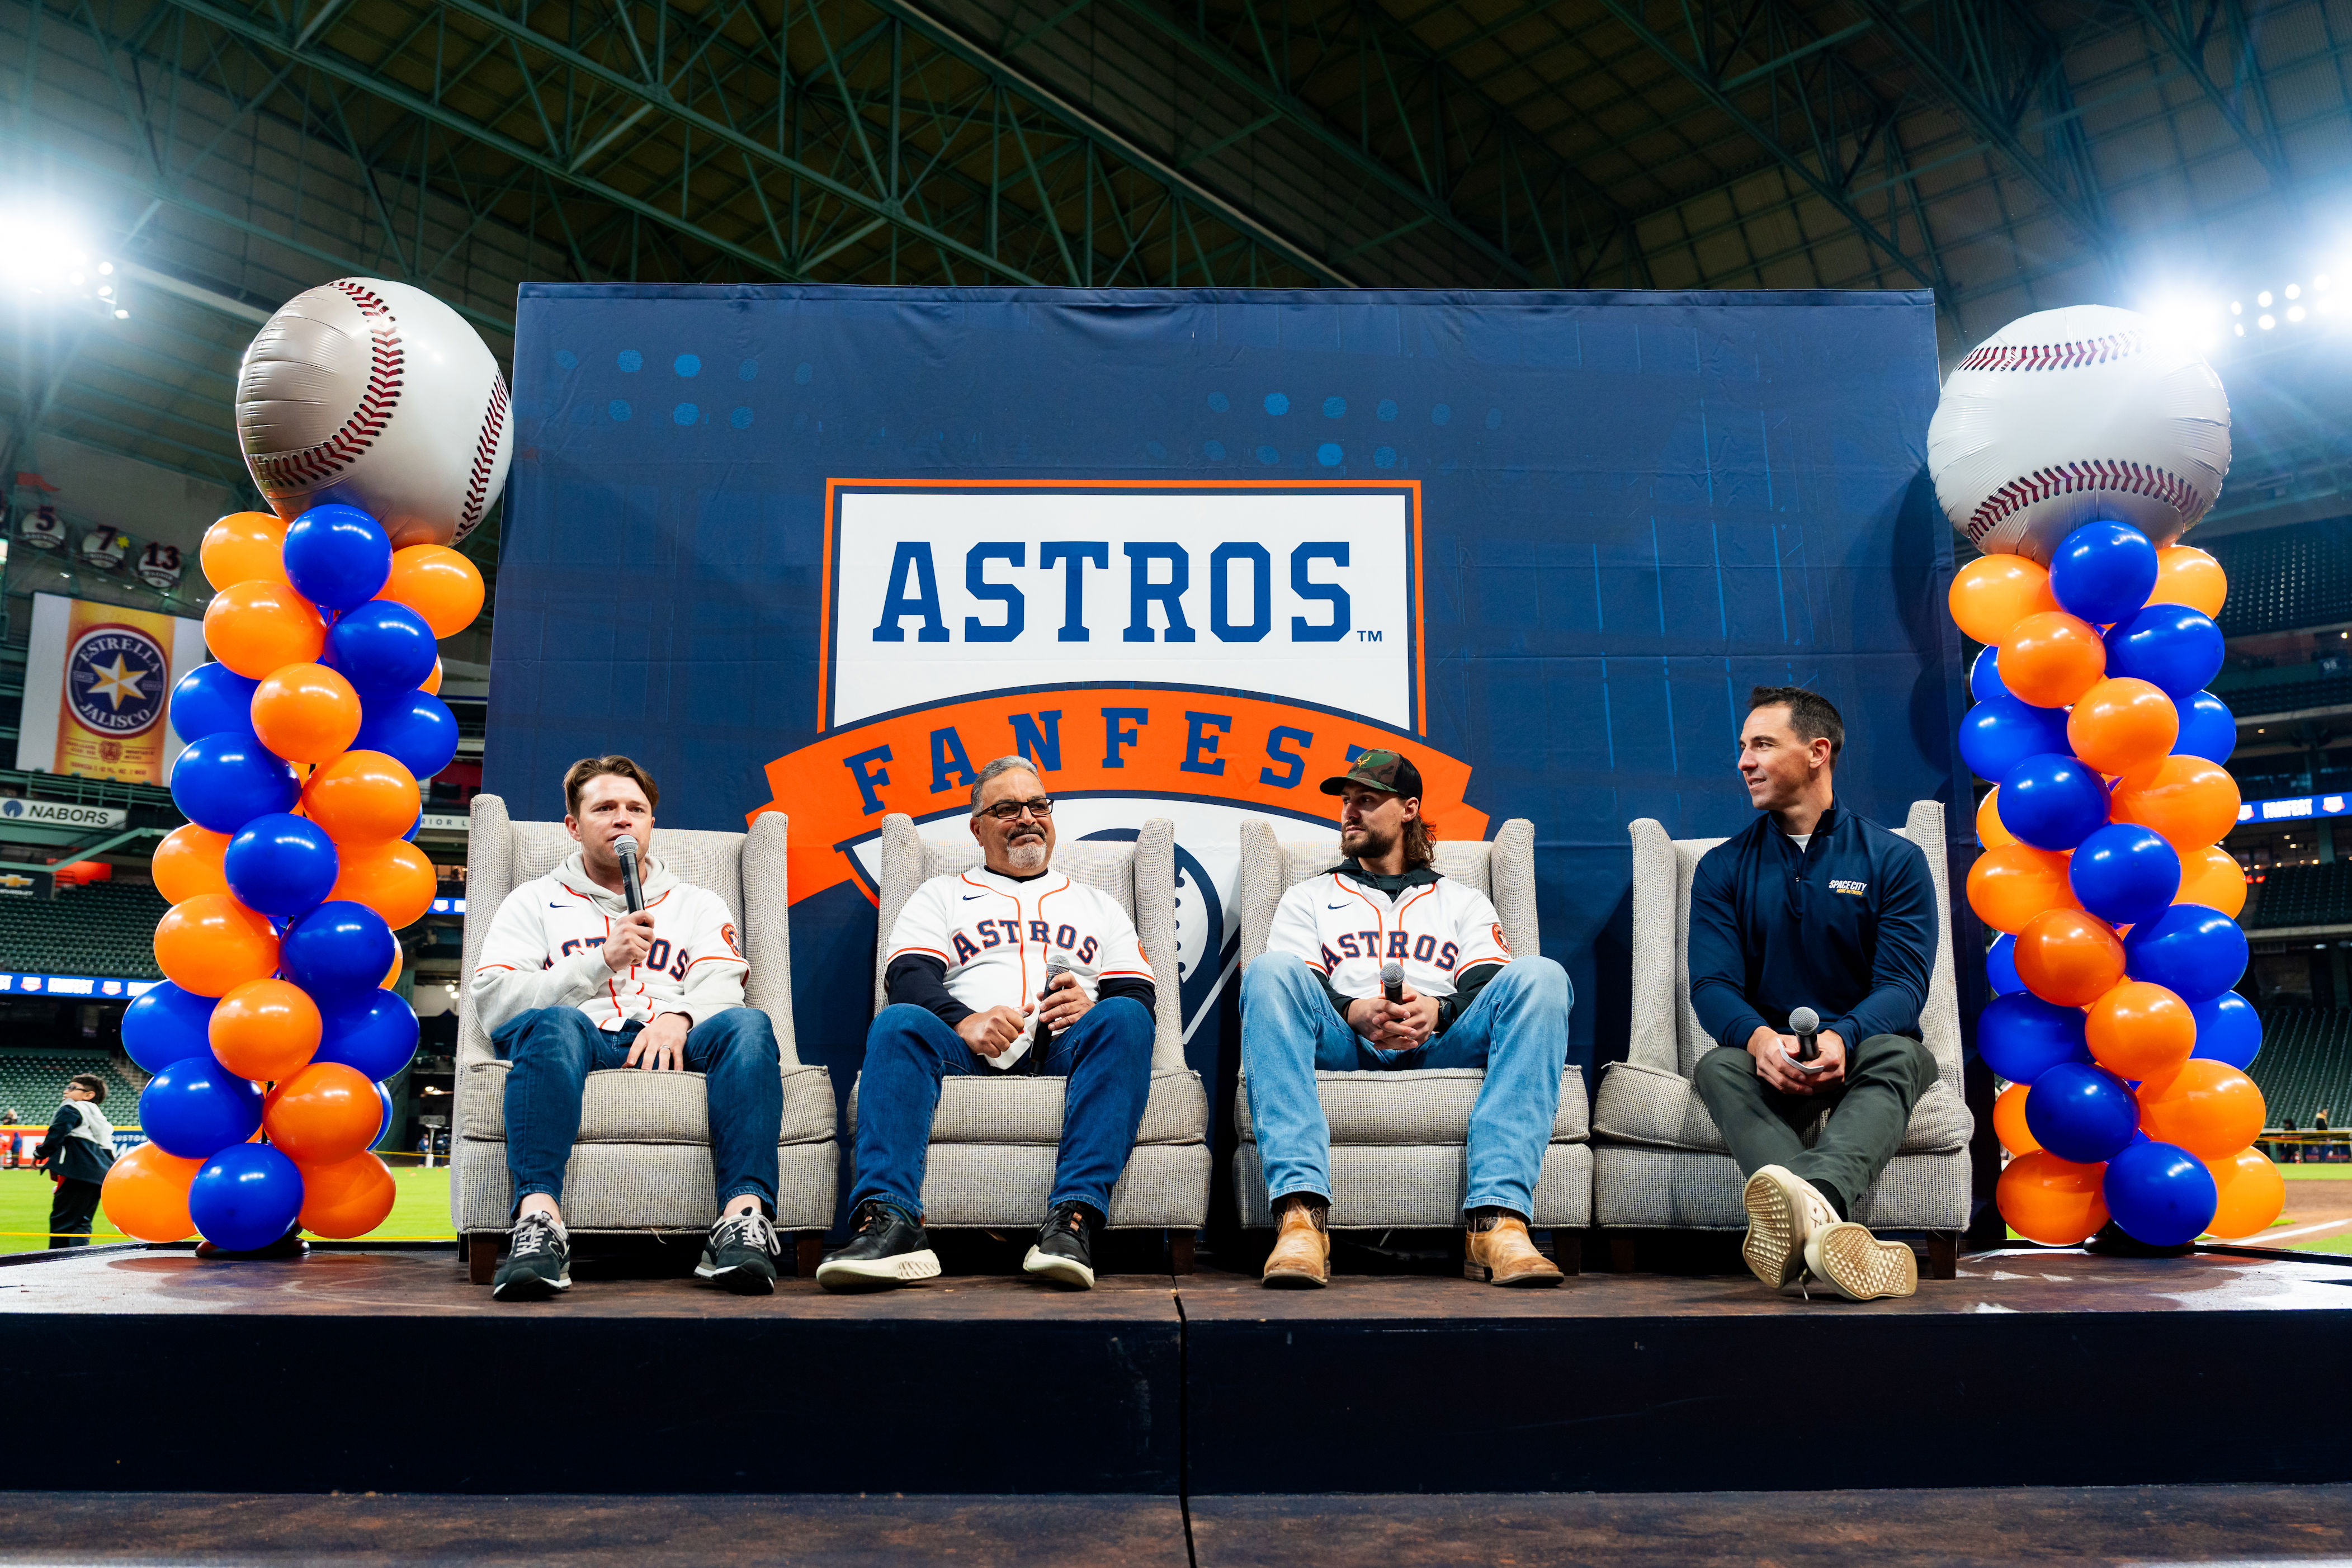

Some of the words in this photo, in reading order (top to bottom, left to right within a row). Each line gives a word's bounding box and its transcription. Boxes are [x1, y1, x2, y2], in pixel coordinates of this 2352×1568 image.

[35, 504, 55, 531] 5
[96, 523, 118, 551] 7
[145, 541, 180, 570] 13
[872, 541, 1351, 643] ASTROS
[1357, 630, 1383, 642] TM
[79, 637, 160, 673] ESTRELLA
[79, 702, 151, 728] JALISCO
[843, 707, 1370, 816] FANFES
[29, 804, 109, 825] NABORS
[1828, 880, 1852, 889] SPACE
[1850, 881, 1867, 892] CITY
[952, 919, 1098, 966] ASTROS
[1321, 930, 1459, 977] ASTROS
